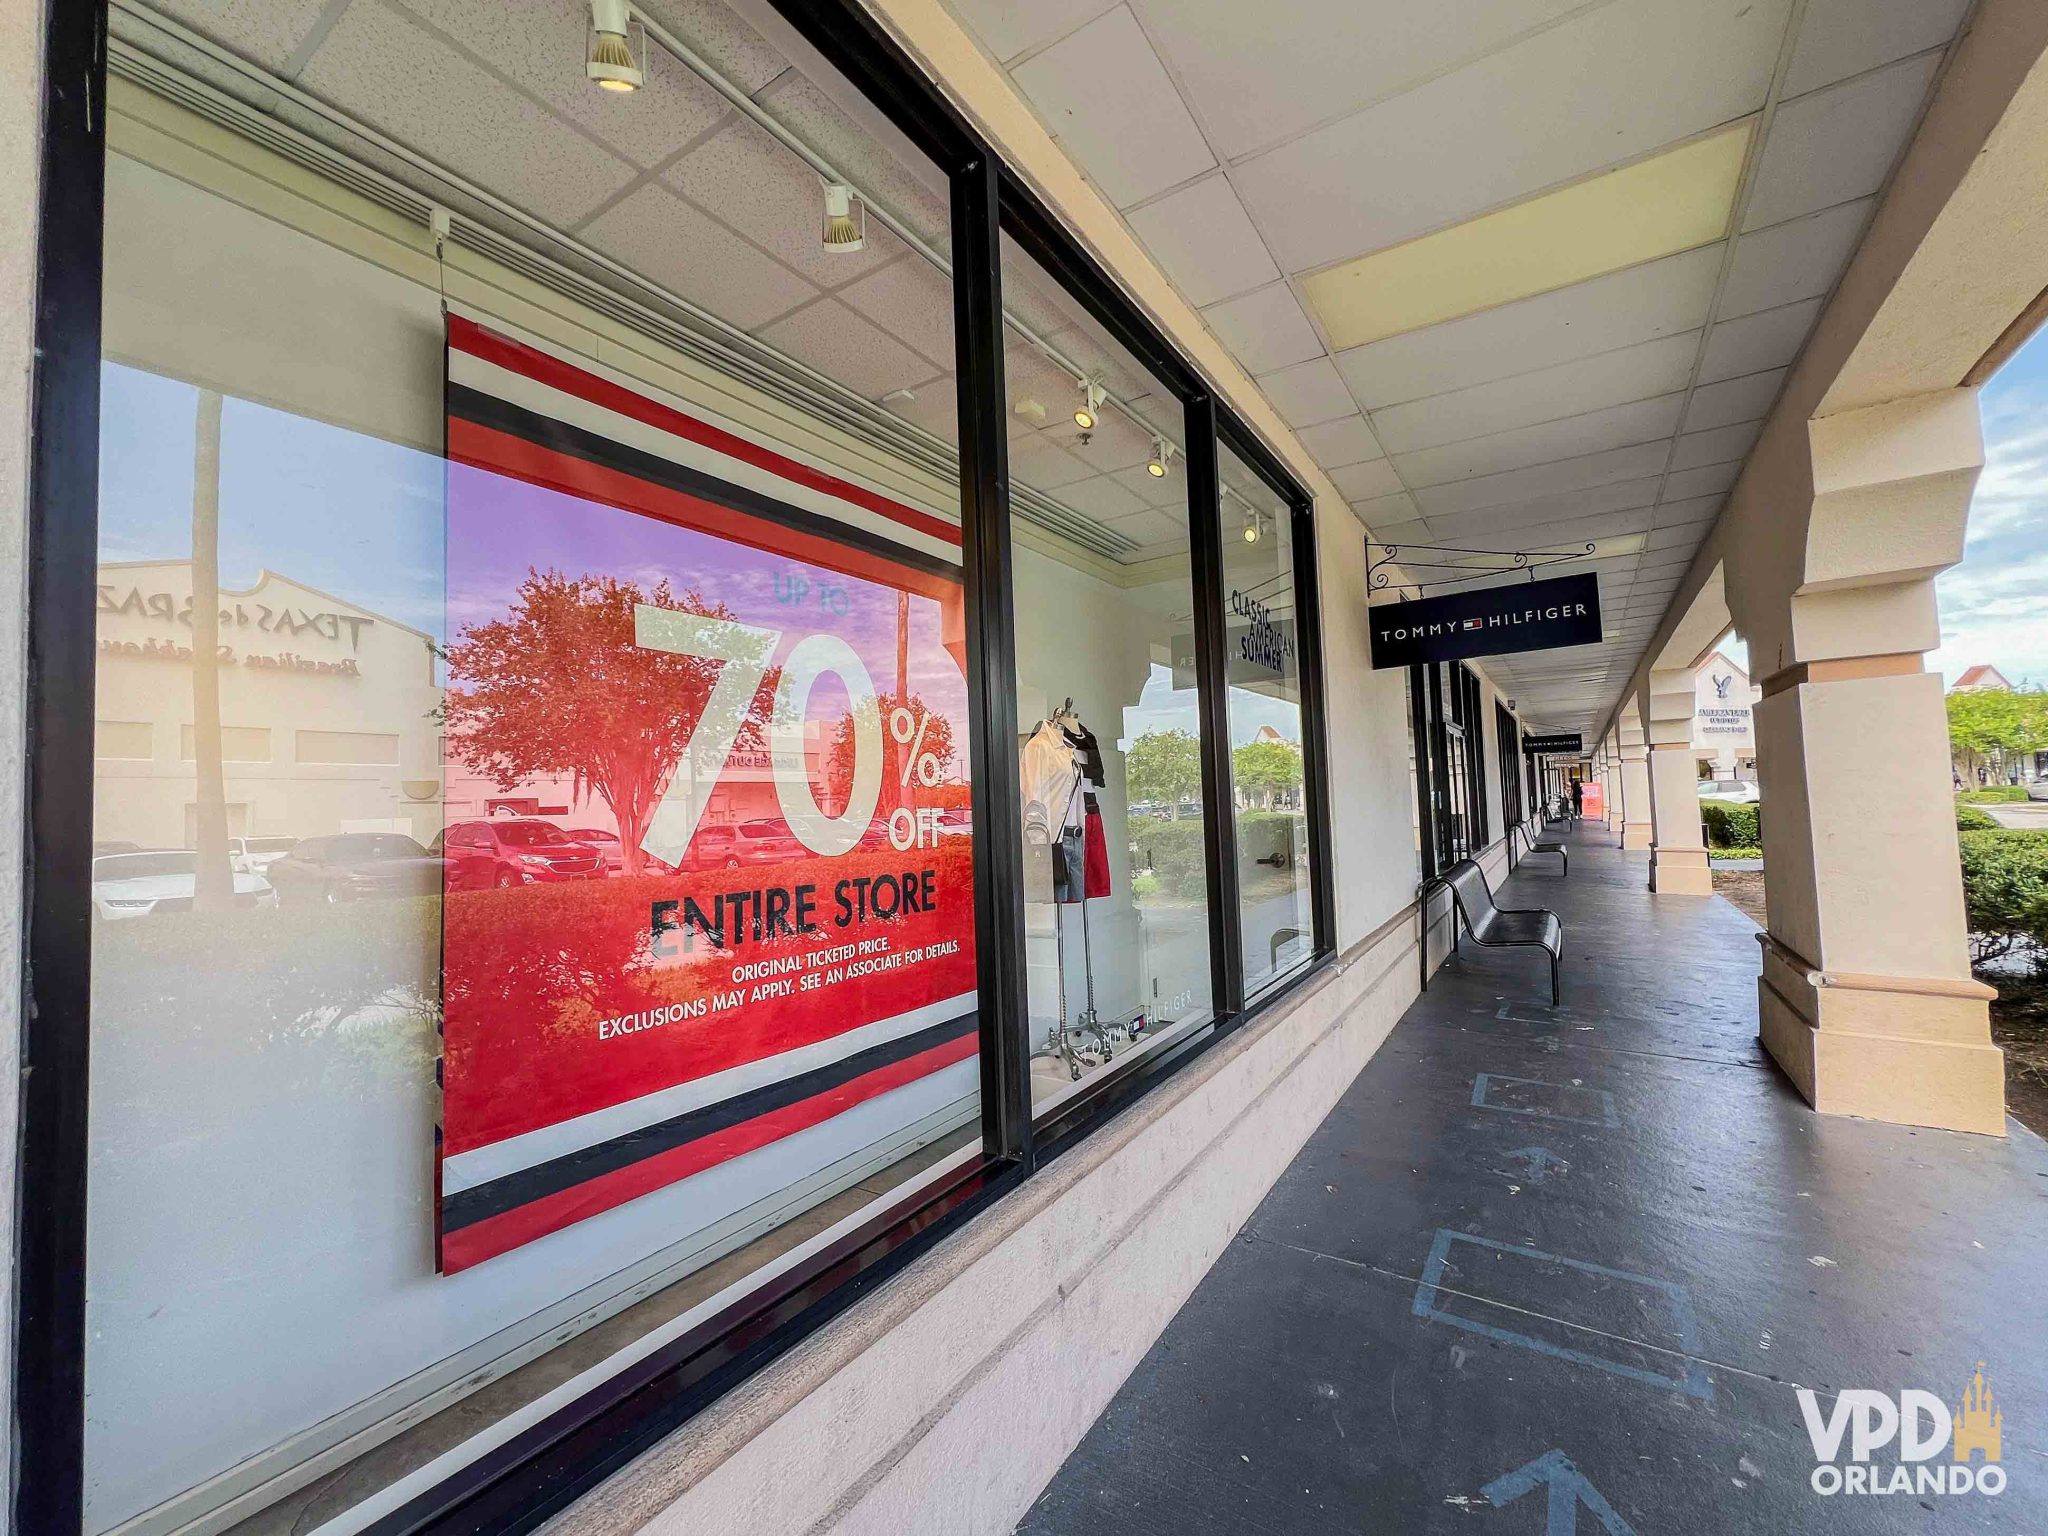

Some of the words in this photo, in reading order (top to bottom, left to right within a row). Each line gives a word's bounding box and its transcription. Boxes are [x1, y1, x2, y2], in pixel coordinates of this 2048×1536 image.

[773, 572, 810, 607] UP
[817, 582, 849, 617] TO
[1232, 590, 1271, 630] CLASSIC
[1247, 619, 1295, 659] AMERICAN
[1381, 622, 1457, 642] TOMMY
[1489, 604, 1587, 627] HILFIGER
[1241, 636, 1283, 673] SUMMER
[634, 602, 884, 869] 70
[887, 807, 944, 852] OFF
[651, 884, 818, 961] ENTIRE
[834, 869, 936, 928] STORE
[731, 956, 803, 984] ORIGINAL
[805, 943, 856, 967] TICKETED
[858, 936, 892, 956] PRICE.
[598, 997, 708, 1041] EXCLUSIONS
[711, 988, 748, 1013] MAY
[750, 978, 796, 1004] APPLY.
[799, 971, 823, 992] SEE
[826, 968, 844, 986] AN
[845, 951, 903, 980] ASSOCIATE
[904, 948, 924, 966] FOR
[925, 939, 961, 962] DETAILS.
[1081, 1023, 1131, 1061] TOMMY
[1146, 989, 1193, 1027] HILFIGER
